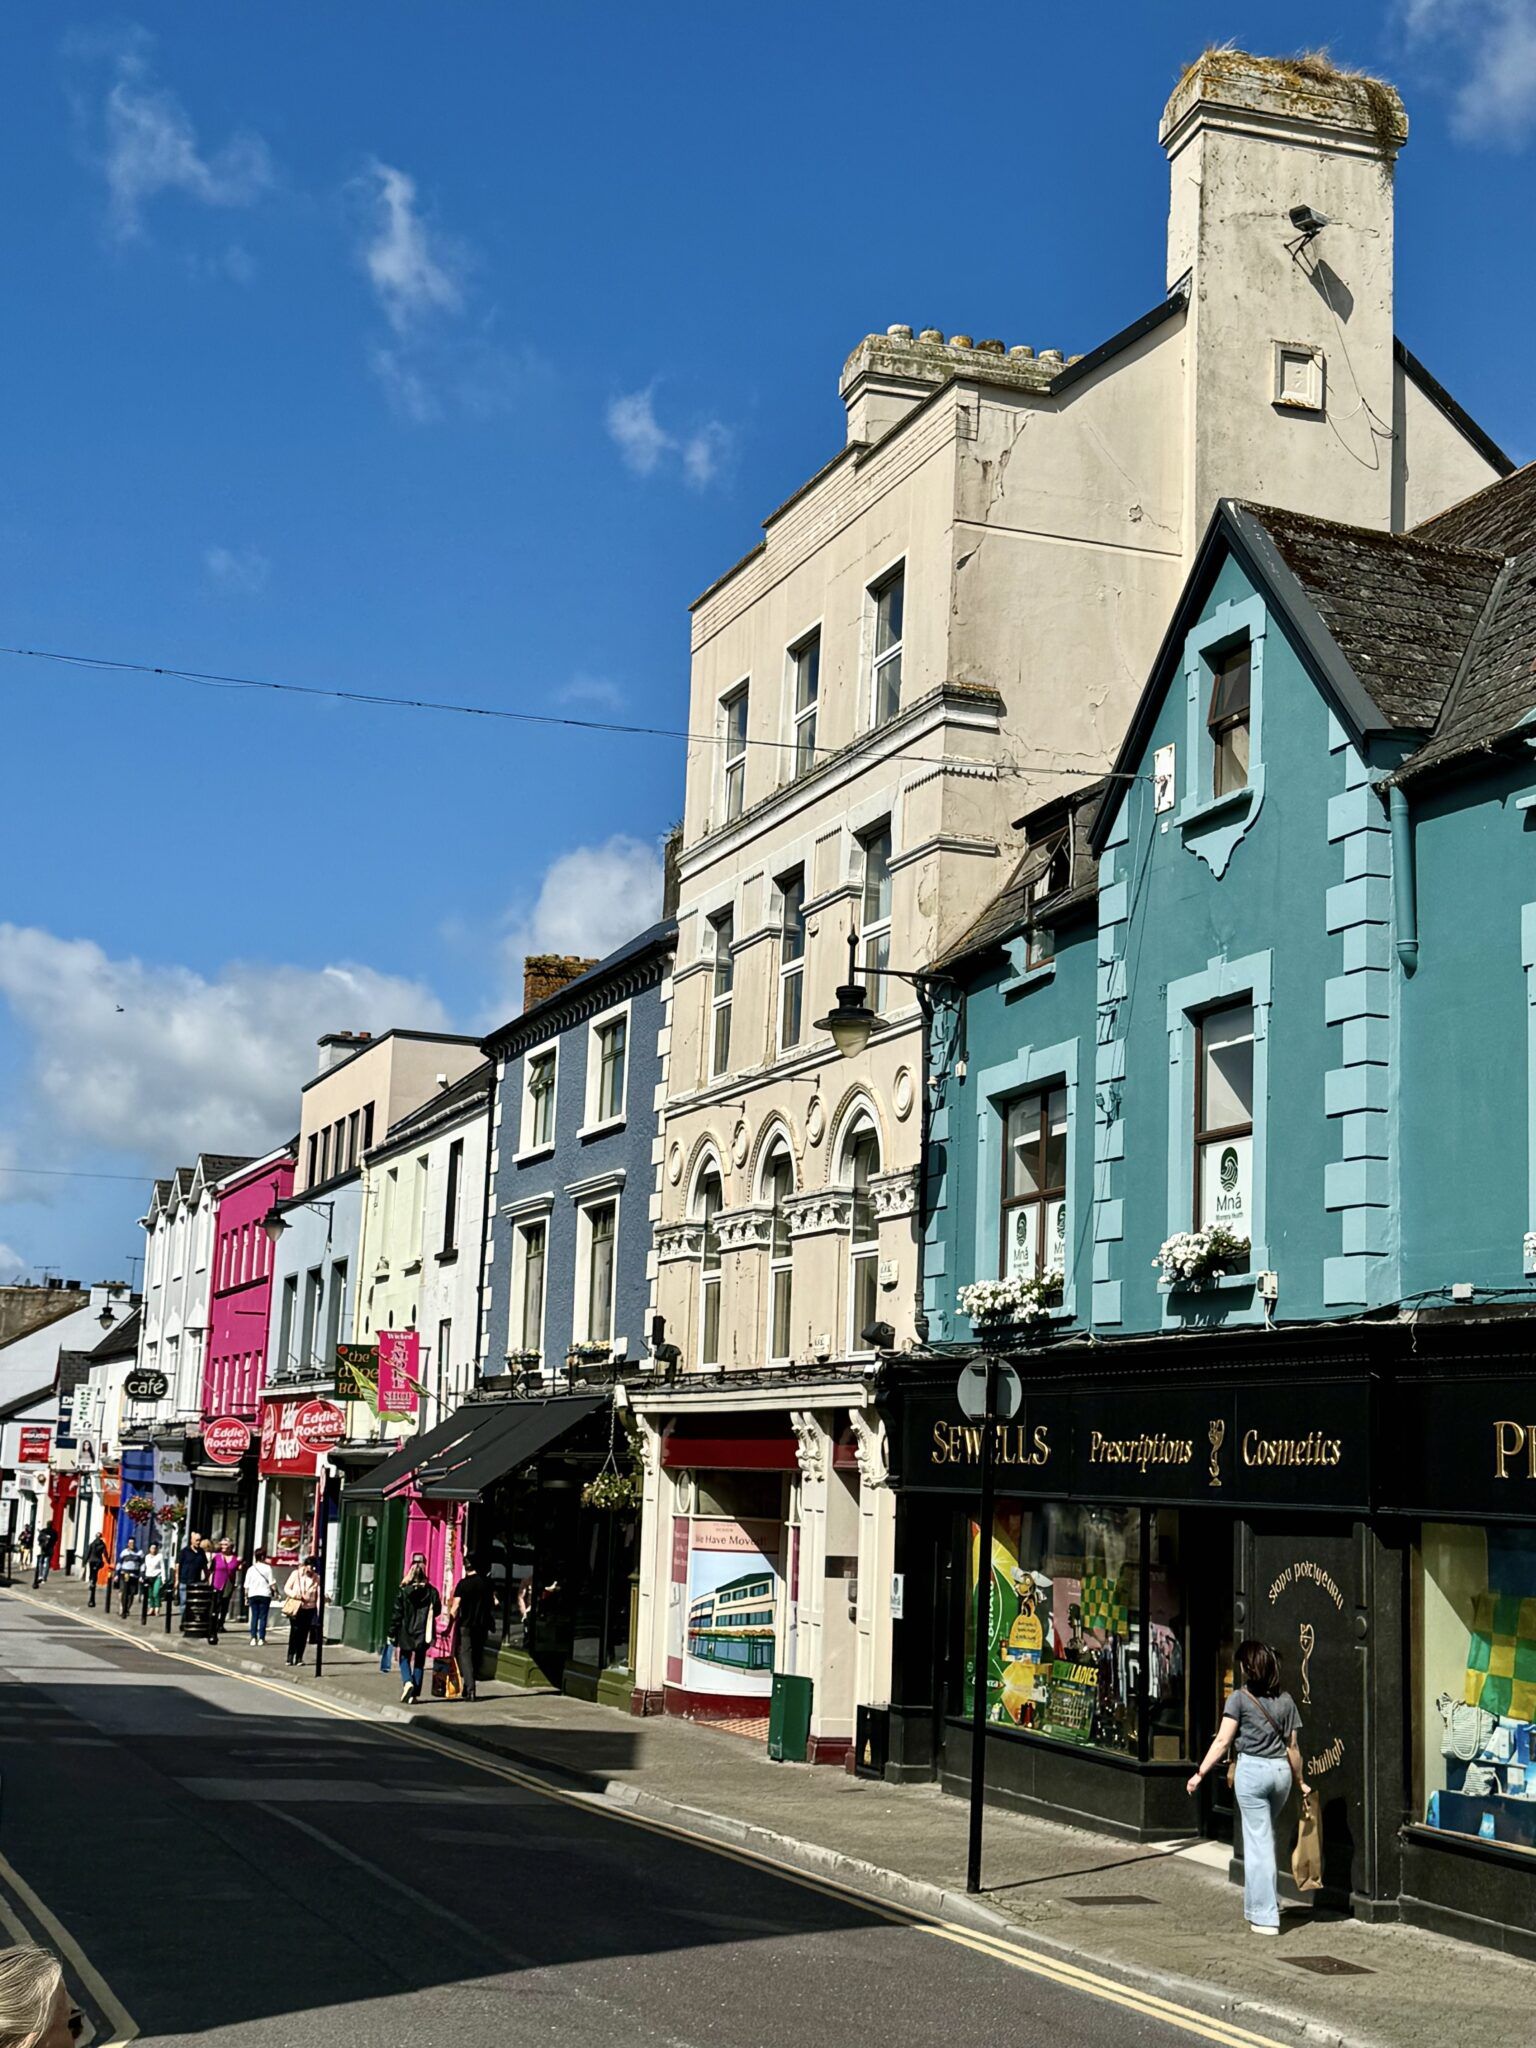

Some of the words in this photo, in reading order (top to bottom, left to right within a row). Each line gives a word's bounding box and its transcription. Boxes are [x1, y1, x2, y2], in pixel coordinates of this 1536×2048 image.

[1216, 1192, 1242, 1211] Mná
[348, 1350, 370, 1363] the
[128, 1378, 164, 1395] café
[303, 1410, 339, 1425] Eddie
[213, 1427, 245, 1438] Eddie
[296, 1419, 346, 1436] Rocket's
[206, 1436, 249, 1448] Rocket's
[931, 1420, 1051, 1465] SEWLLS
[1243, 1429, 1342, 1466] Cosmetics
[1089, 1431, 1193, 1473] Prescriptions
[705, 1535, 727, 1545] Have
[1070, 1663, 1099, 1687] LADIES
